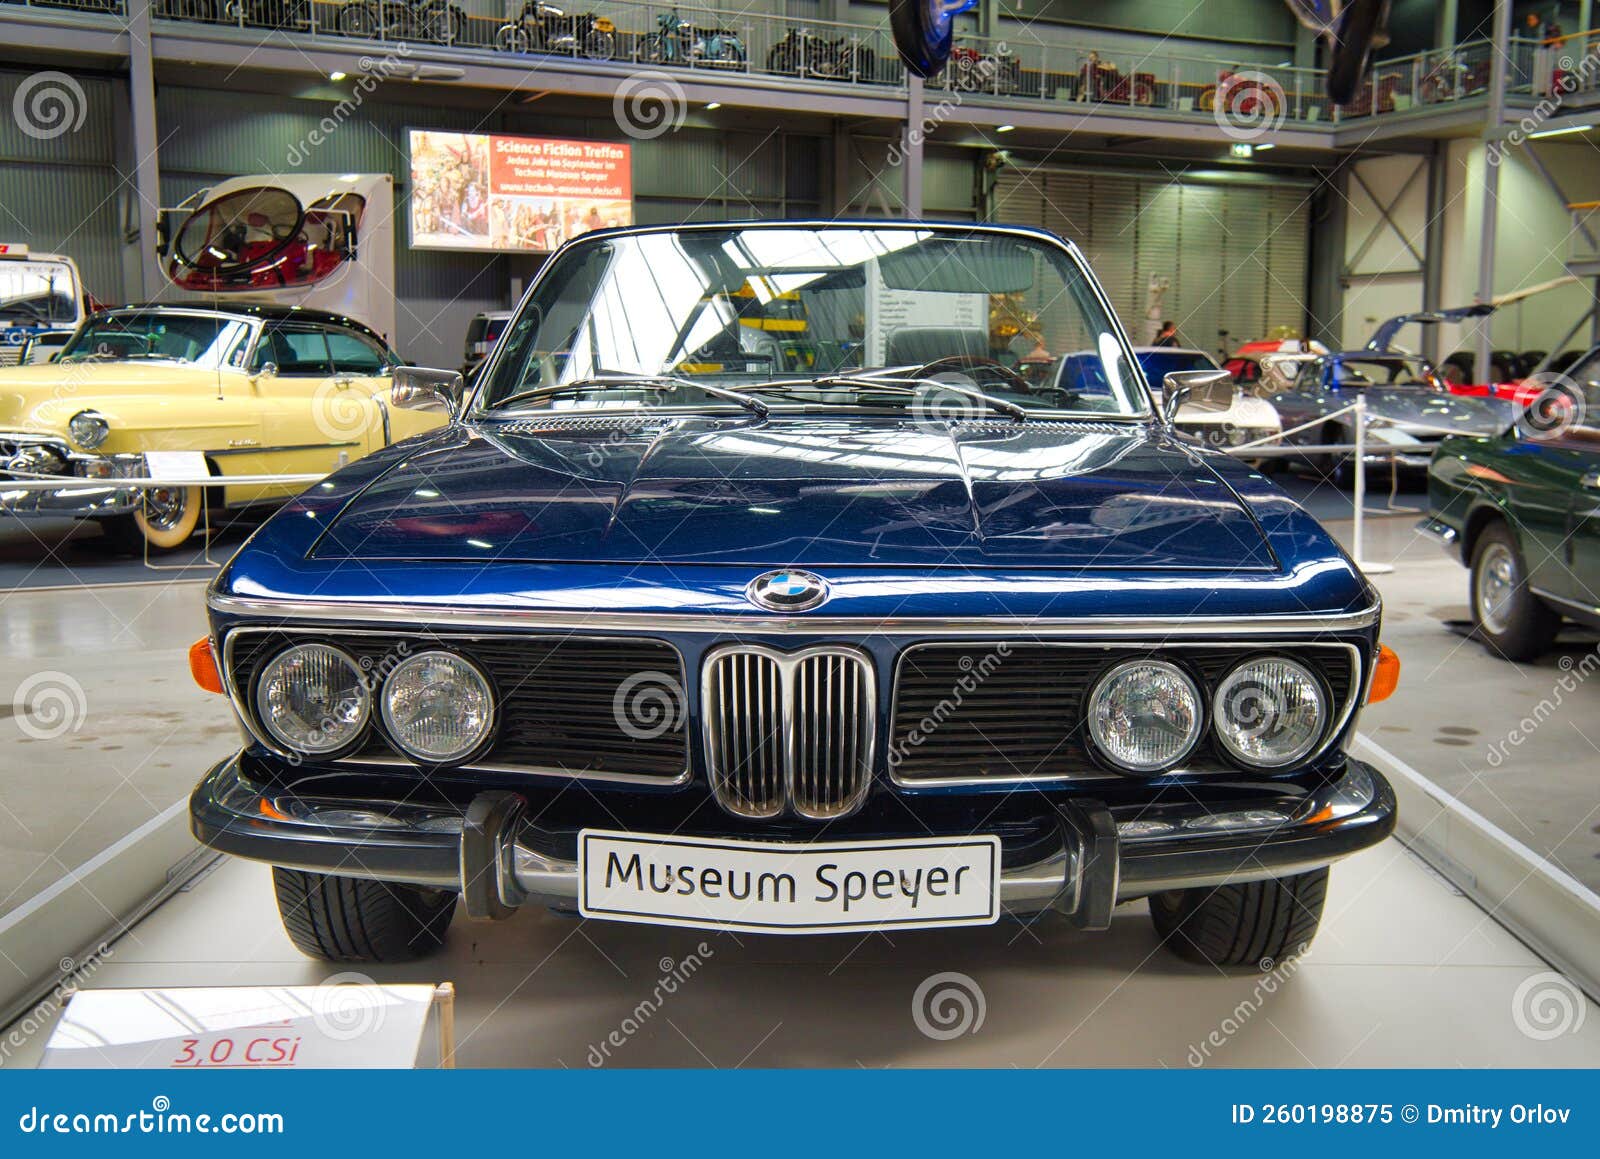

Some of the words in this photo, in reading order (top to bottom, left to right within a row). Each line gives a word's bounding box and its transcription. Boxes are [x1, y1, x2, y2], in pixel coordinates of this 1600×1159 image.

[496, 140, 541, 155] Science
[543, 143, 582, 157] Fiction
[584, 145, 624, 159] Treffen
[506, 156, 529, 166] Jedes
[561, 159, 604, 171] September
[514, 167, 545, 178] Technik
[546, 169, 580, 180] Museum
[581, 171, 608, 182] Speyer
[604, 851, 797, 903] Museum
[814, 863, 971, 912] Speyer
[173, 1038, 235, 1067] 3,0
[244, 1036, 302, 1063] CSi
